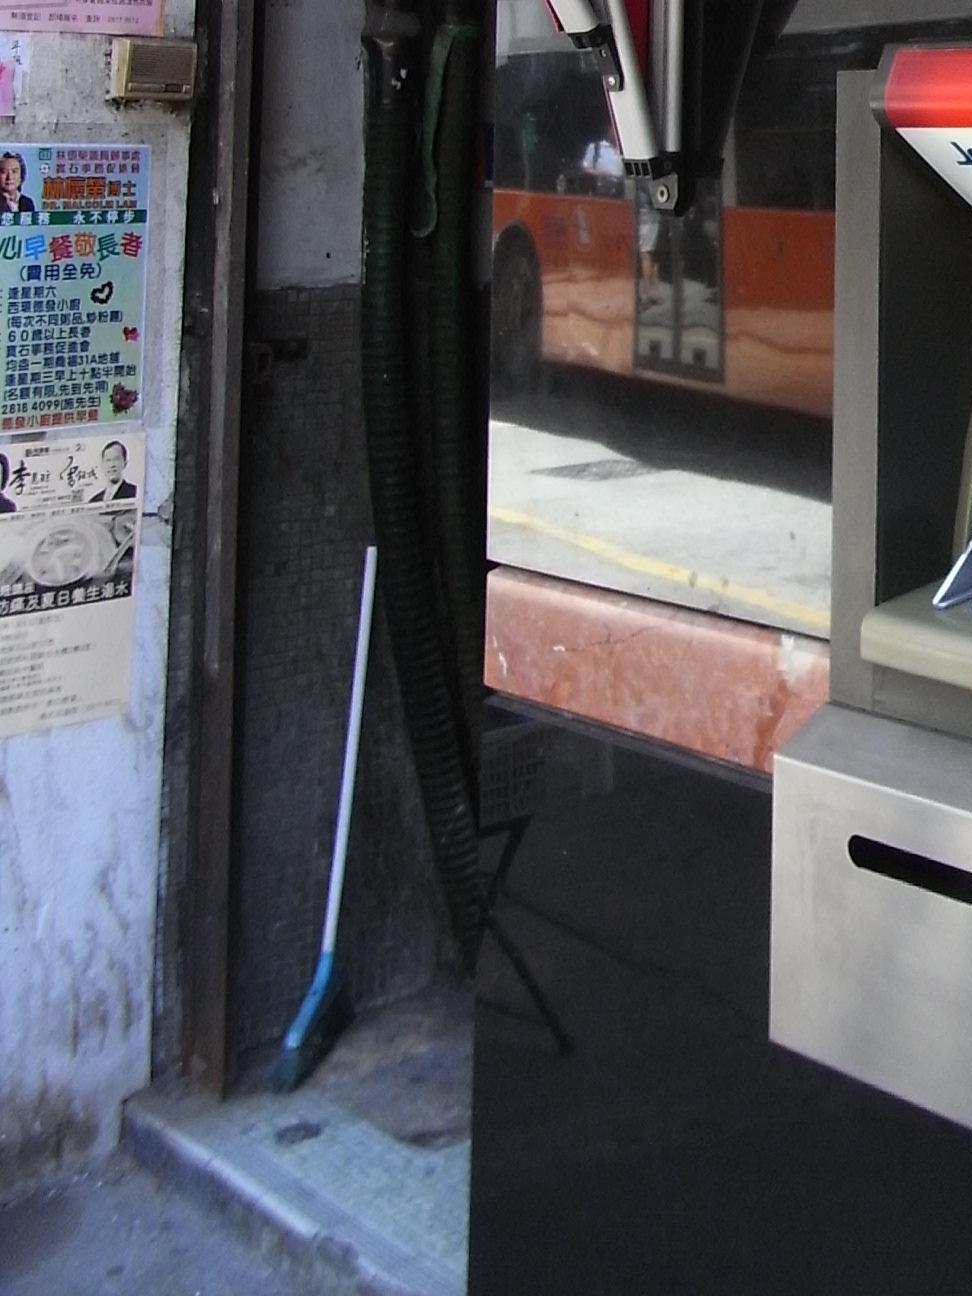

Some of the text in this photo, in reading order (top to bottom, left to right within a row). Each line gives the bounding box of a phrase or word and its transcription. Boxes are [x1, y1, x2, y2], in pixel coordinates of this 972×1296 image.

[0, 231, 142, 262] 心早餐敬長者
